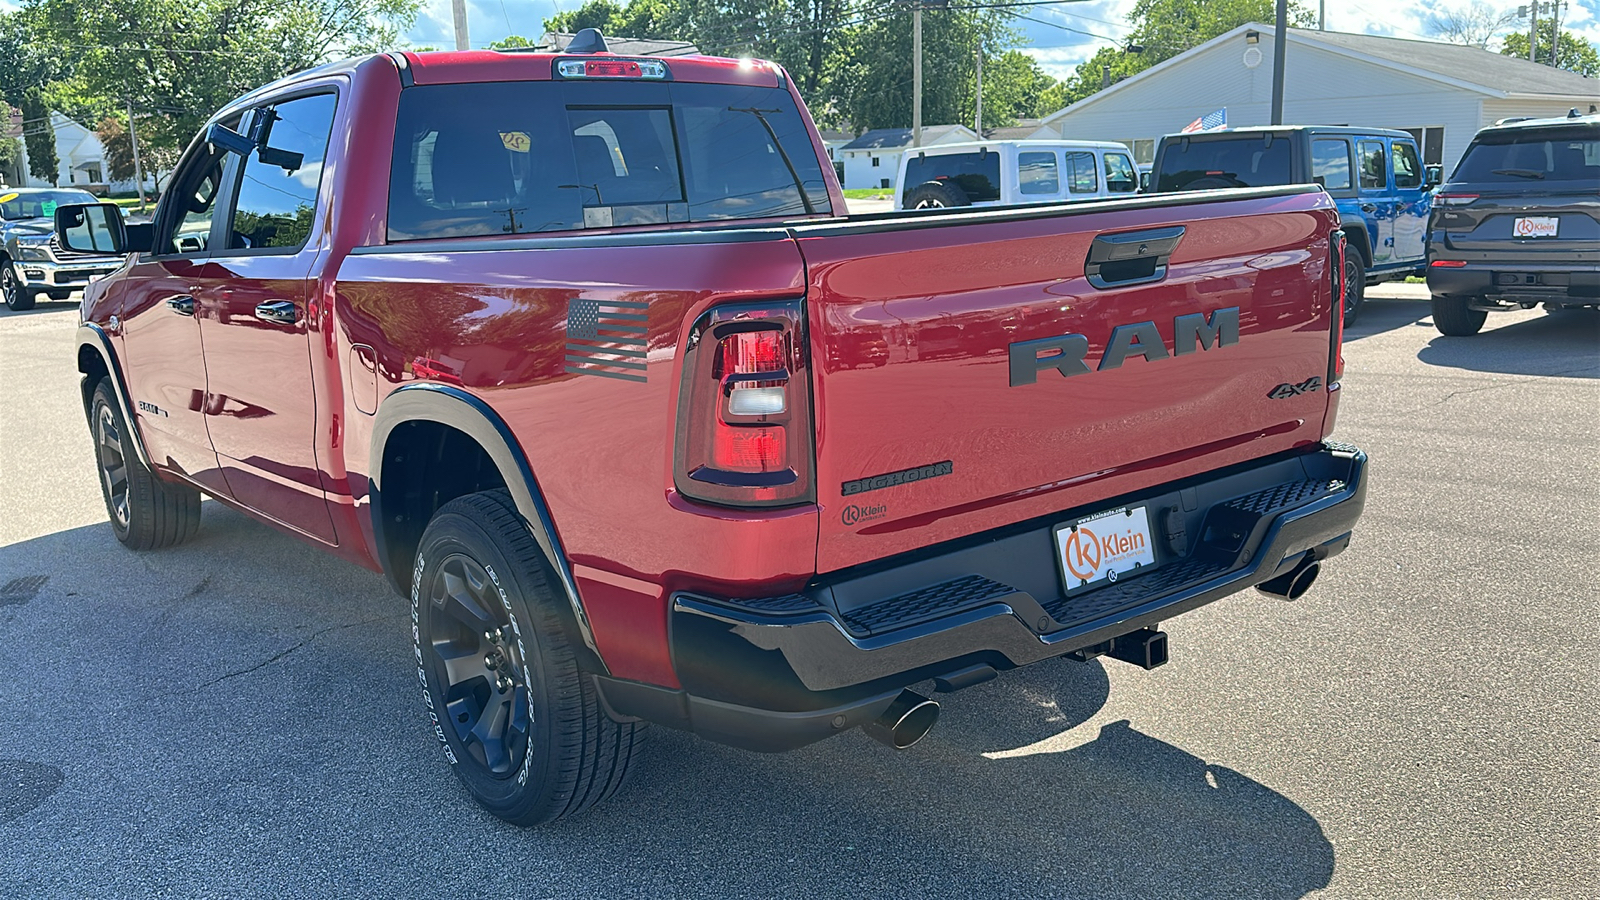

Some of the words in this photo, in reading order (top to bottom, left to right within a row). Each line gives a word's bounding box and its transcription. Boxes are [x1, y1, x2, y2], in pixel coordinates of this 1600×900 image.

[1535, 223, 1555, 231] Klein
[1009, 306, 1240, 387] RAM
[139, 401, 159, 415] RAM
[841, 460, 953, 497] BIGHORN
[861, 504, 887, 517] Klein
[1077, 507, 1127, 524] www.kleinauto.com
[1101, 529, 1145, 558] Klein
